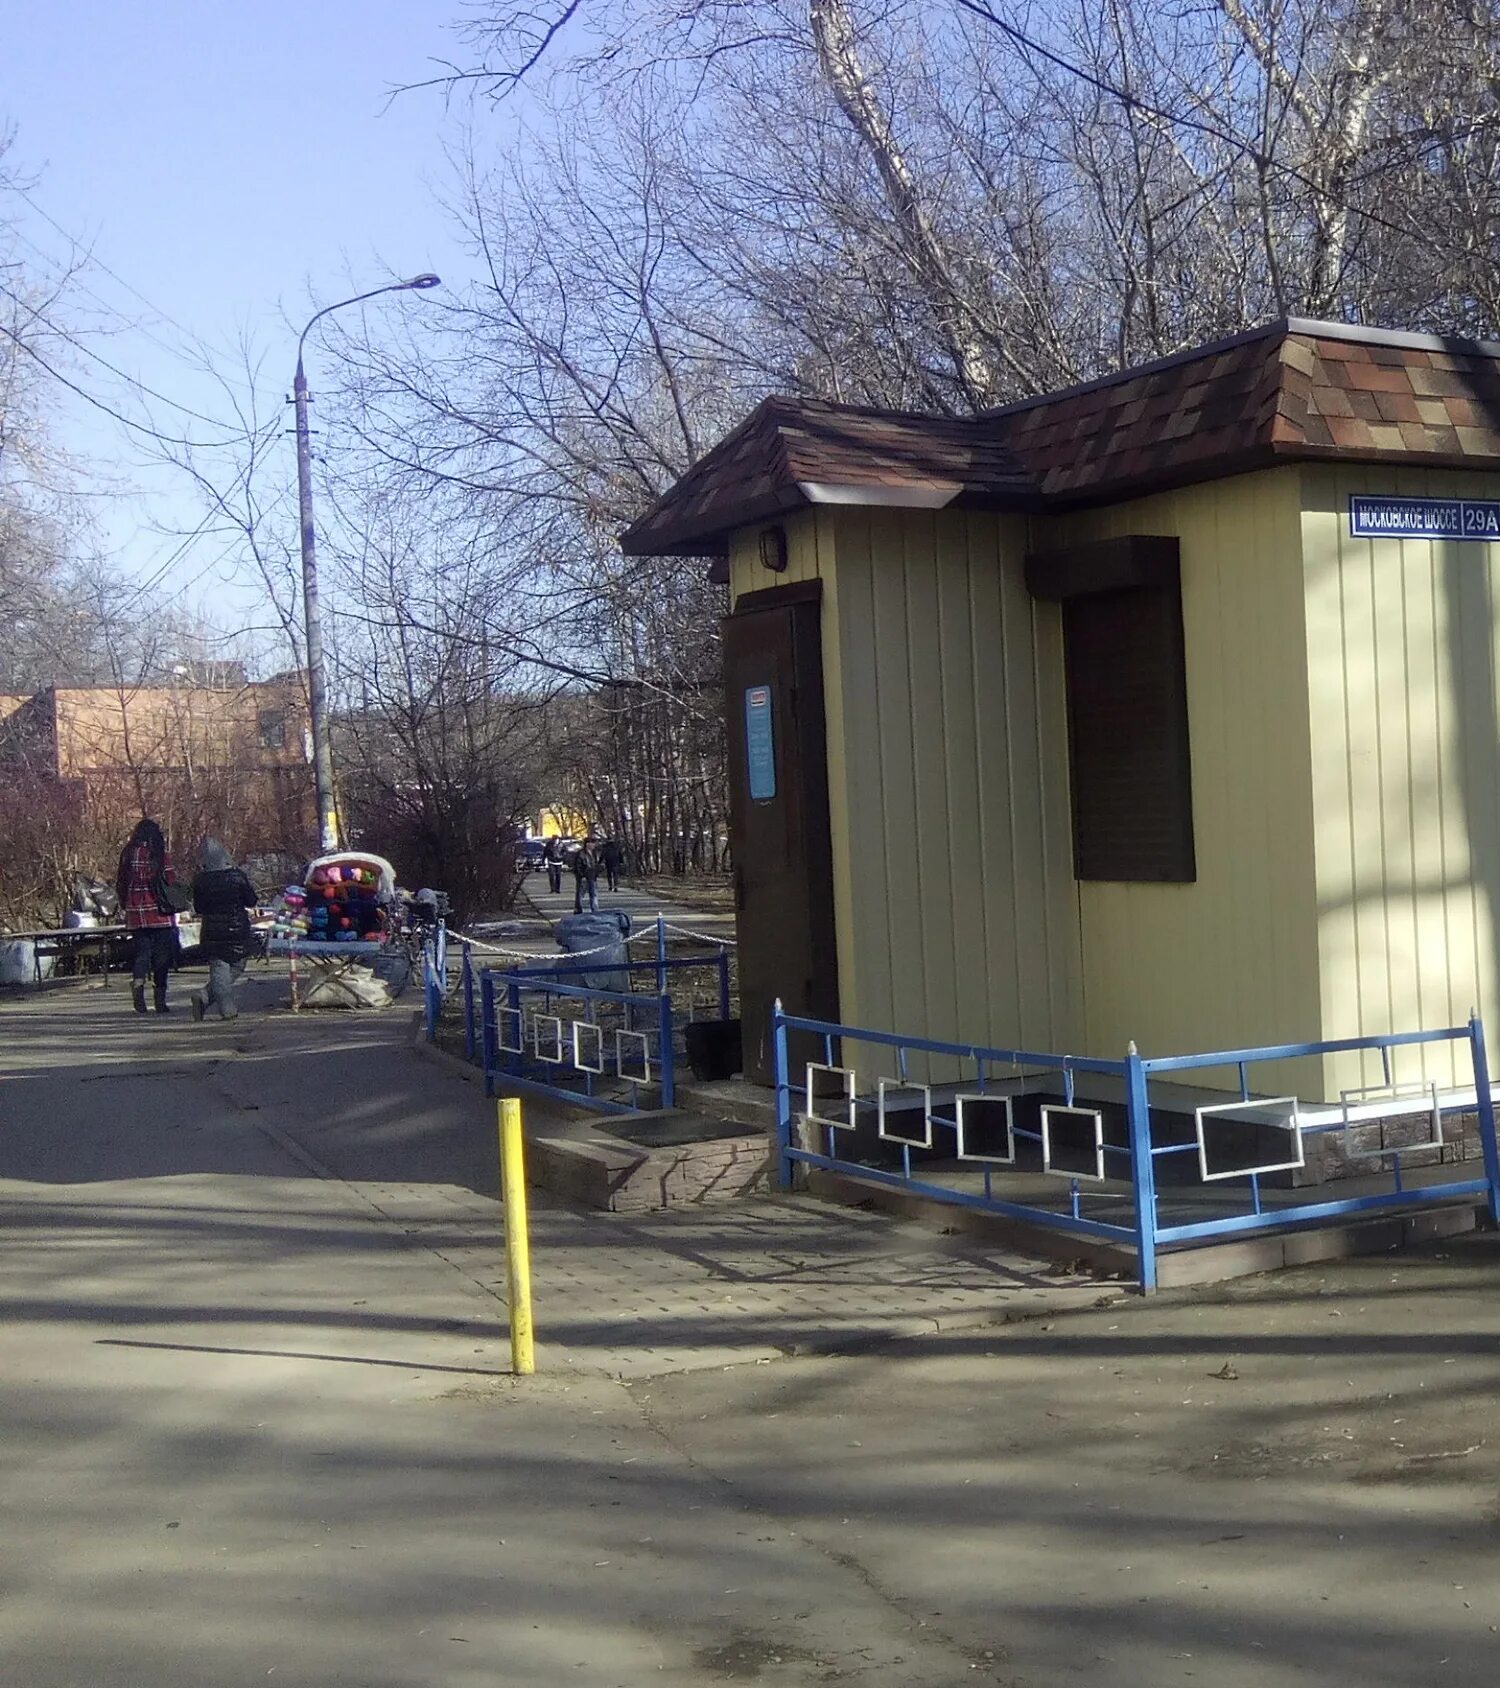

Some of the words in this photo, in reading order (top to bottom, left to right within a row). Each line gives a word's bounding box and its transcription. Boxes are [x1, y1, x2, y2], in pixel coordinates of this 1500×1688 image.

[1360, 506, 1422, 529] МОСКОВСКОЕ
[1424, 508, 1458, 530] ШОССЕ
[1466, 509, 1498, 531] 29А
